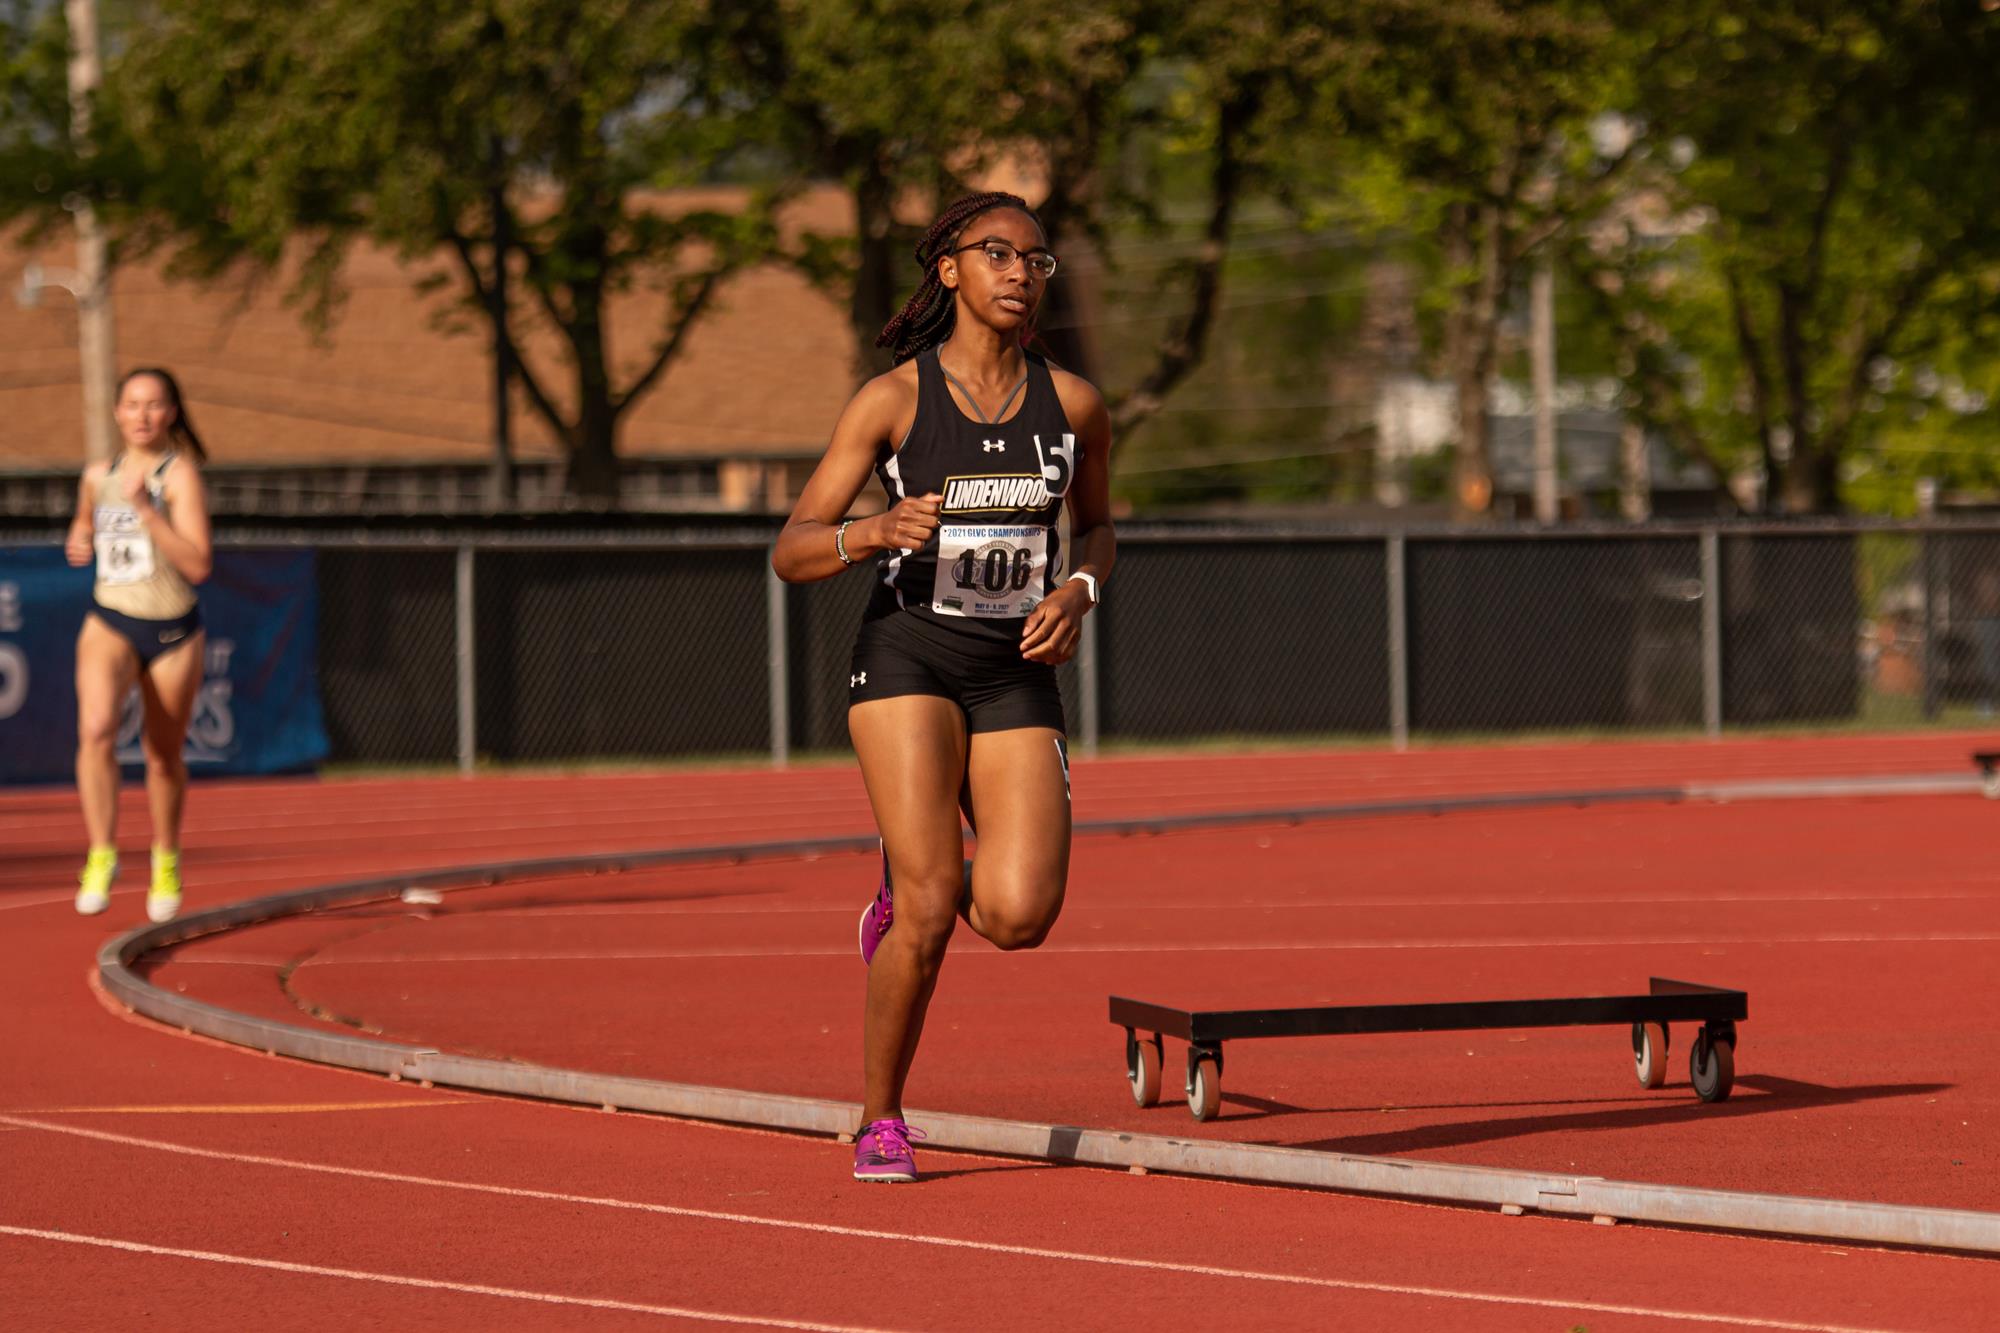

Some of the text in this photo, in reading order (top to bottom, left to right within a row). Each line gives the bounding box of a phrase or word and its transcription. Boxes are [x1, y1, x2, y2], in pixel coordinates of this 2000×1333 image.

[947, 527, 1041, 537] 2021 GLVC CHAMPIONSHIPS
[956, 548, 1031, 592] 106
